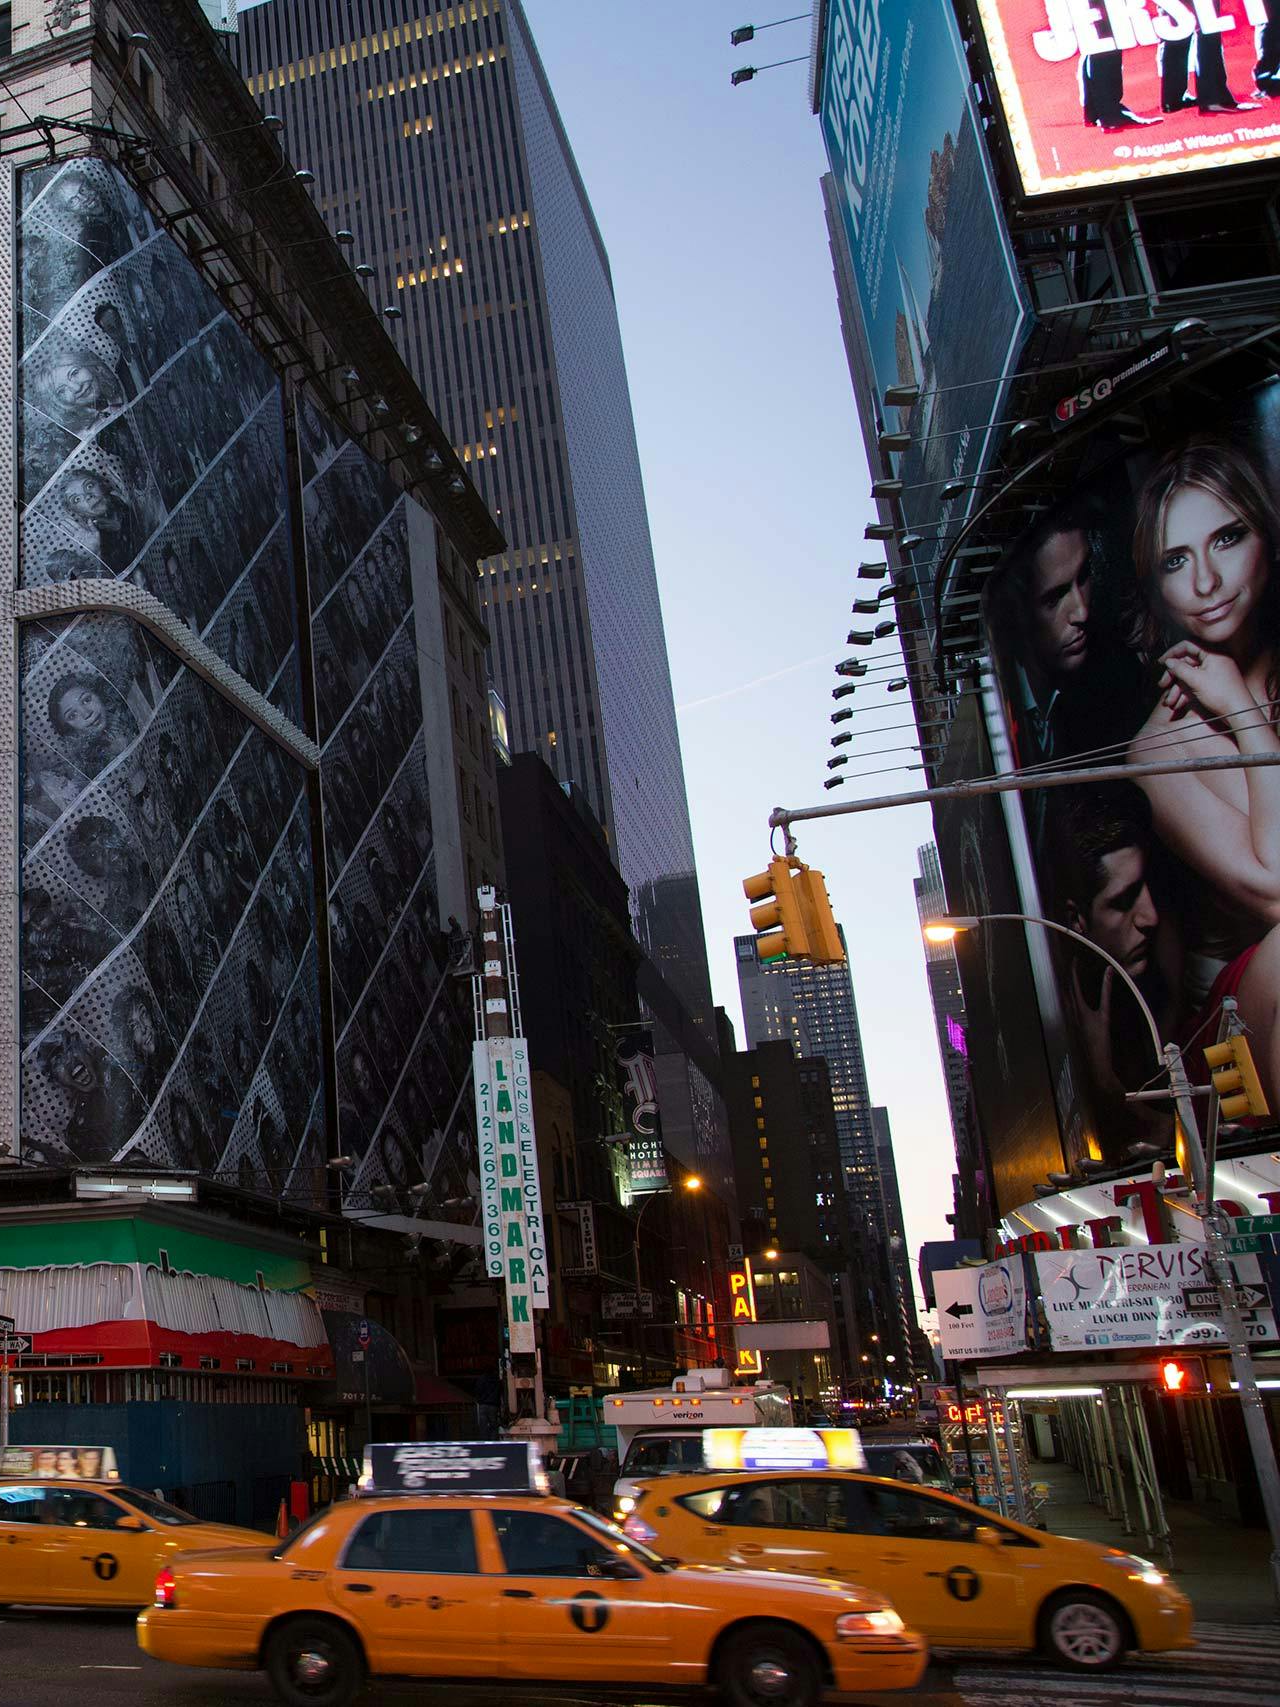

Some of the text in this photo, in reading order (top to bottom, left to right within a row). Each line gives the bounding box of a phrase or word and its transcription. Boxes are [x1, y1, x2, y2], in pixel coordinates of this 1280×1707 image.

[1133, 140, 1185, 159] August
[1185, 133, 1234, 150] Wilson
[514, 1050, 529, 1113] SIGNS
[629, 1141, 663, 1150] NIGHT
[630, 1151, 664, 1159] HOTEL
[496, 1060, 530, 1322] LANDMARK
[521, 1140, 545, 1293] ELECTRICAL
[1195, 1294, 1220, 1305] ONE
[1053, 1302, 1075, 1312] LIVE
[730, 1272, 756, 1365] PAK
[1093, 1313, 1128, 1324] LUNCH
[10, 1341, 25, 1350] WAY
[948, 1347, 964, 1355] VISIT
[672, 1411, 704, 1420] verizon
